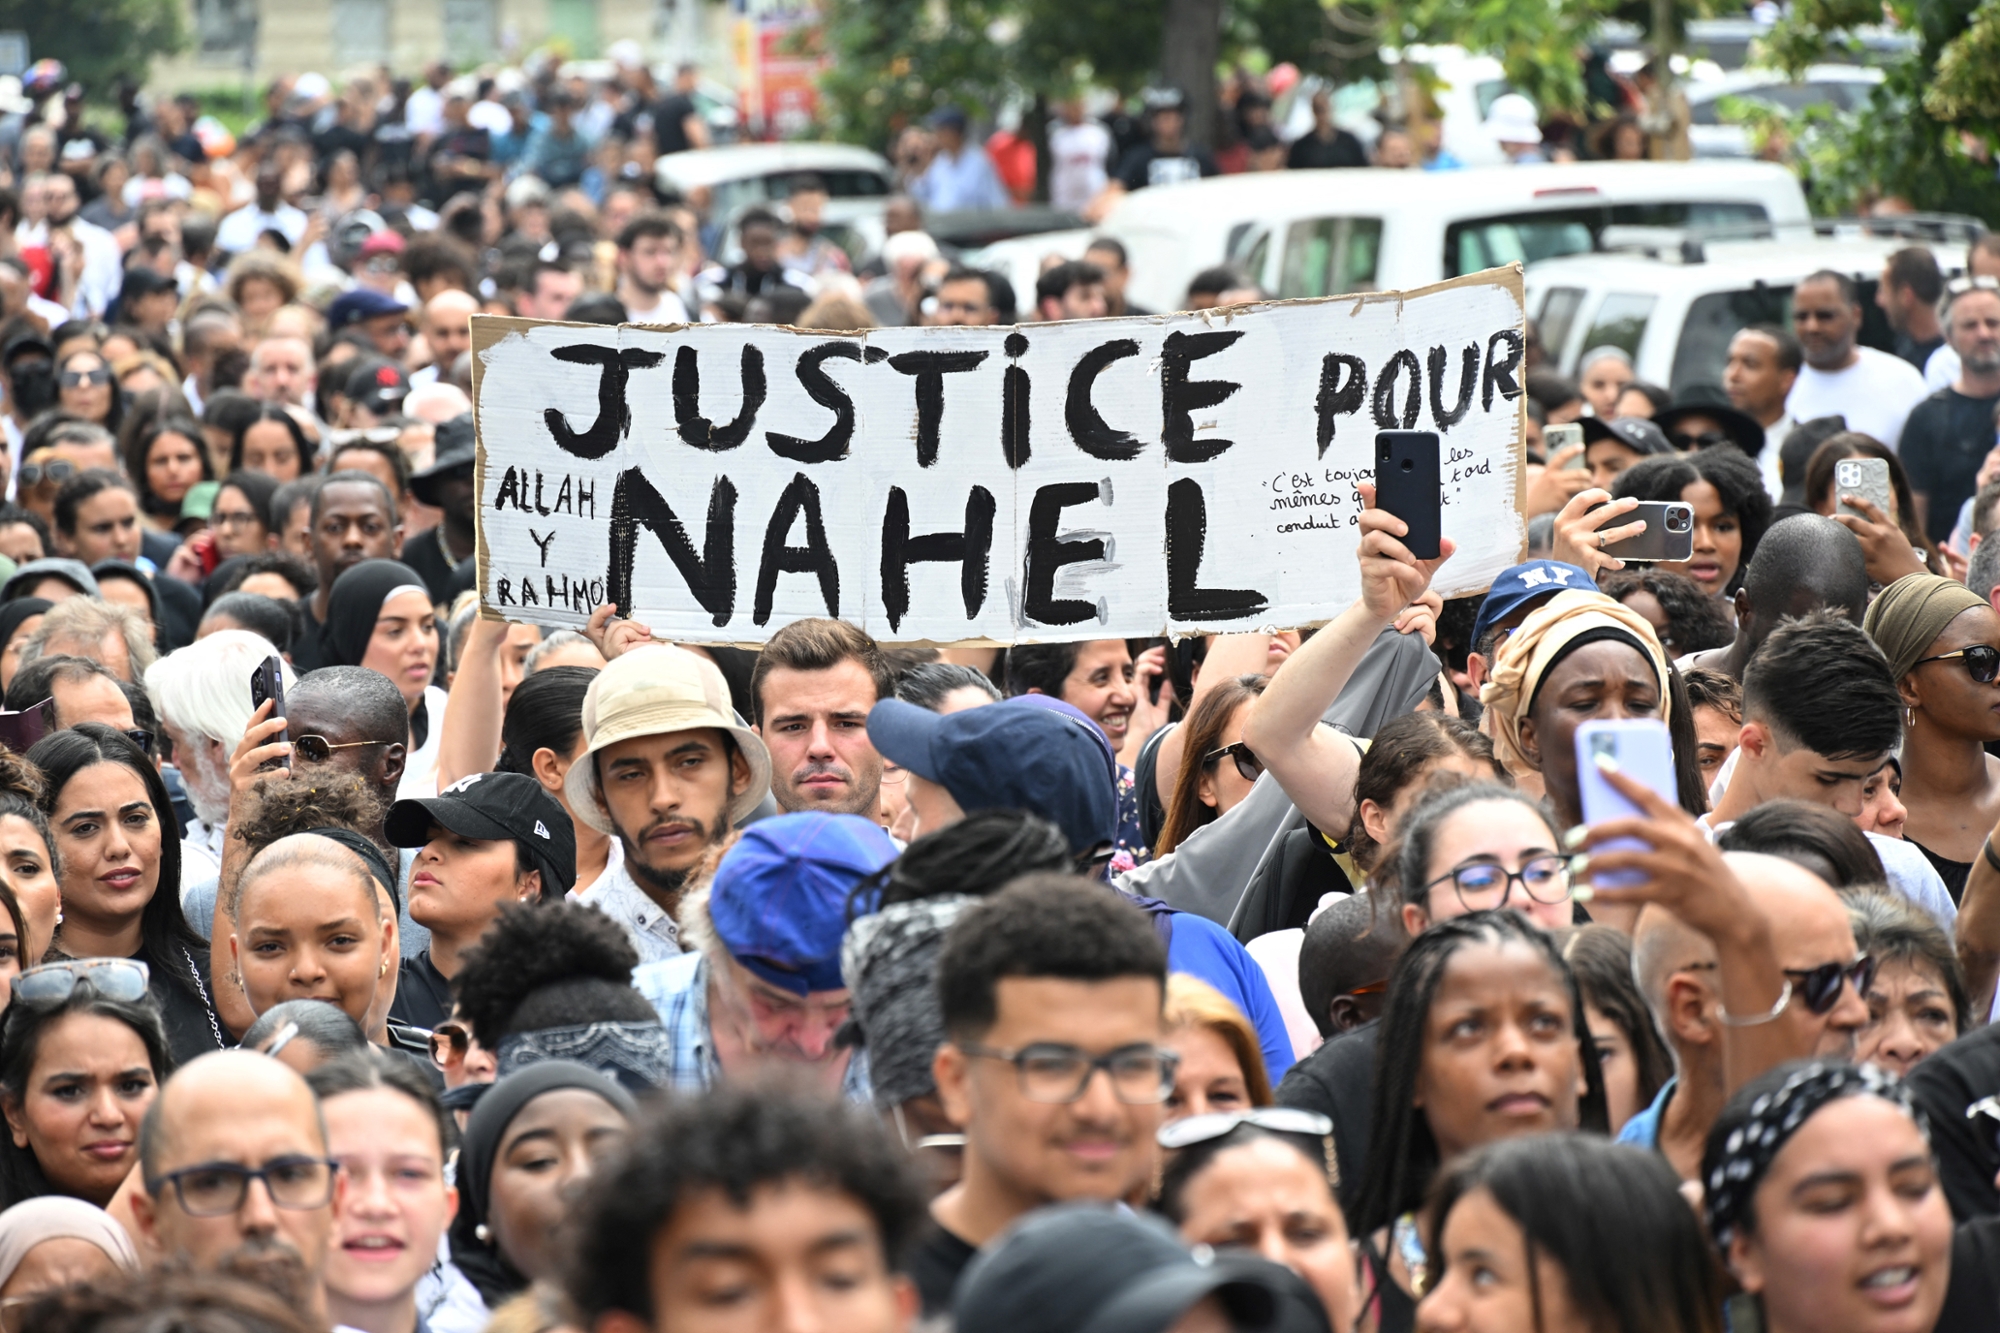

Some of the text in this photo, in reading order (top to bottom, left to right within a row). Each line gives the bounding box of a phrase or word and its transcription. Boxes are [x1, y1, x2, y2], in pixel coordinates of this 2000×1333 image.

[1313, 328, 1525, 461] POUR
[1443, 447, 1474, 465] les
[495, 464, 596, 520] ALLAH
[1269, 489, 1341, 511] mêmes
[1276, 512, 1341, 534] conduit
[528, 527, 556, 568] Y
[606, 464, 1270, 635] NAHEL
[1518, 566, 1574, 589] NY
